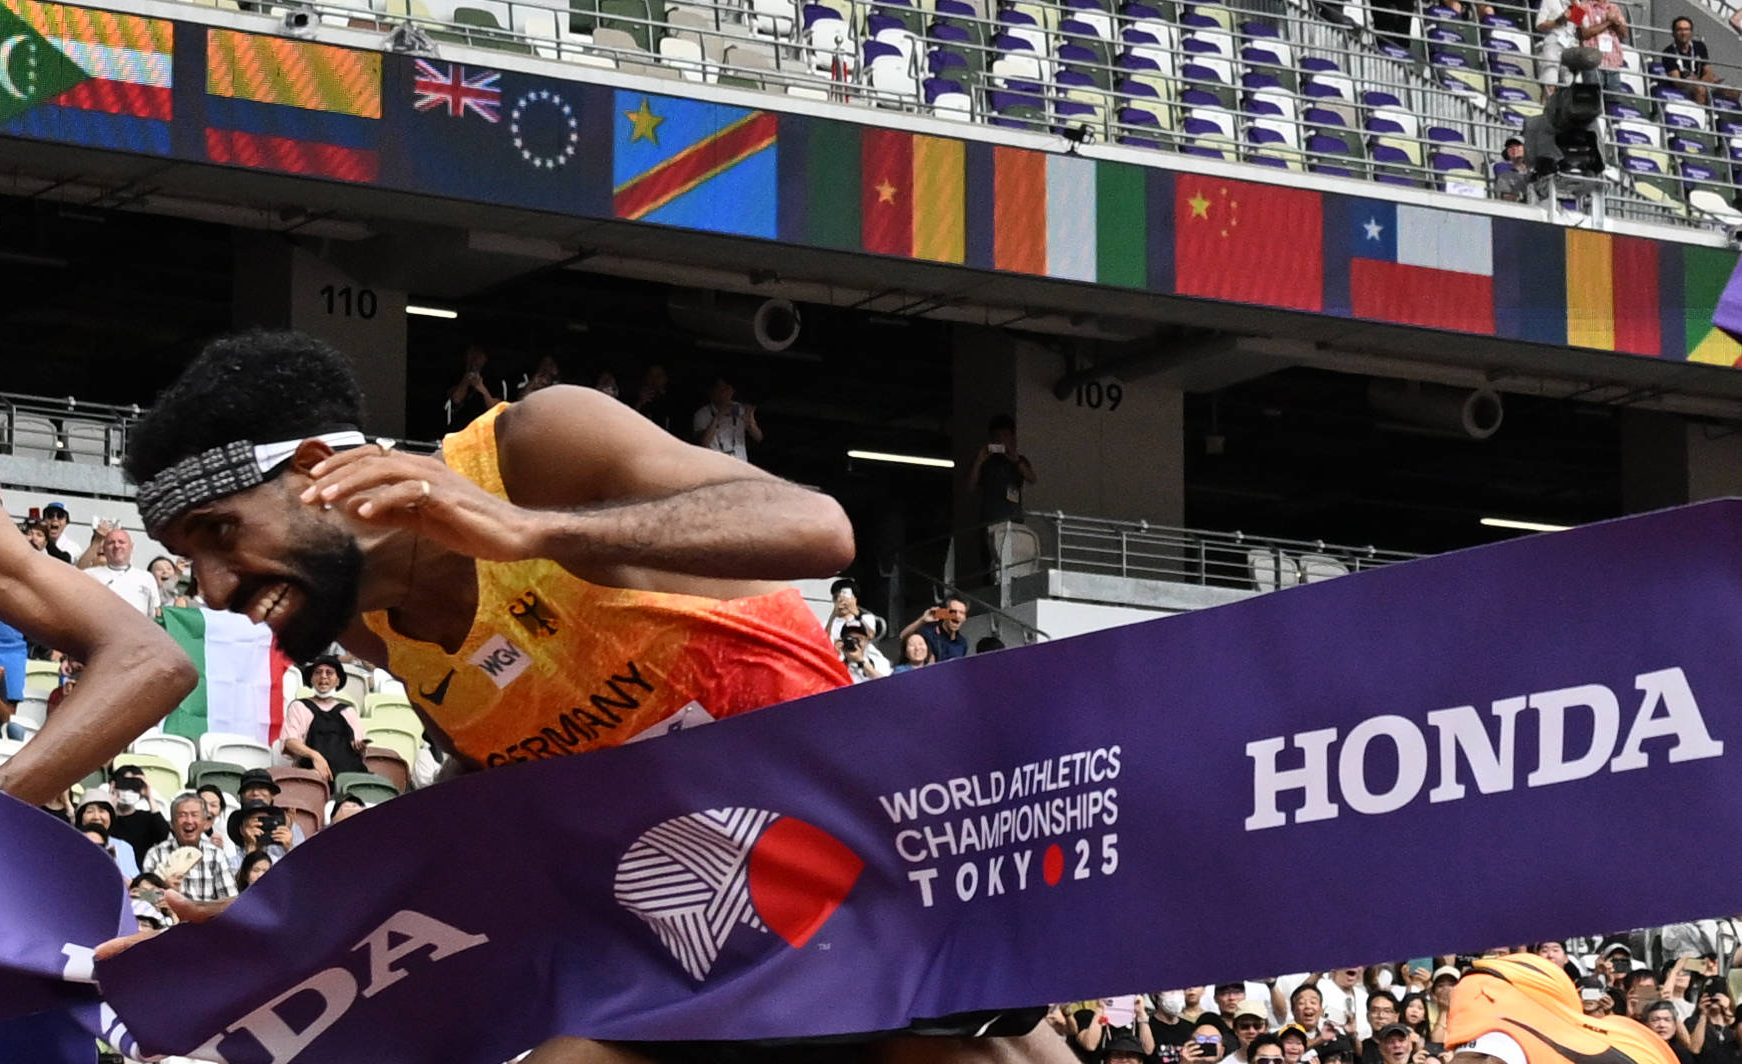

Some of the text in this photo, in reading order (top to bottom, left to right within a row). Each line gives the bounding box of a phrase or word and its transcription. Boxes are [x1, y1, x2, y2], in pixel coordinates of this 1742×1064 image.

[320, 285, 378, 319] 110
[478, 639, 521, 677] WGV
[878, 745, 1121, 824] WORLD ATHLETICS
[1245, 666, 1724, 831] HONDA
[895, 788, 1119, 863] CHAMPIONSHIPS
